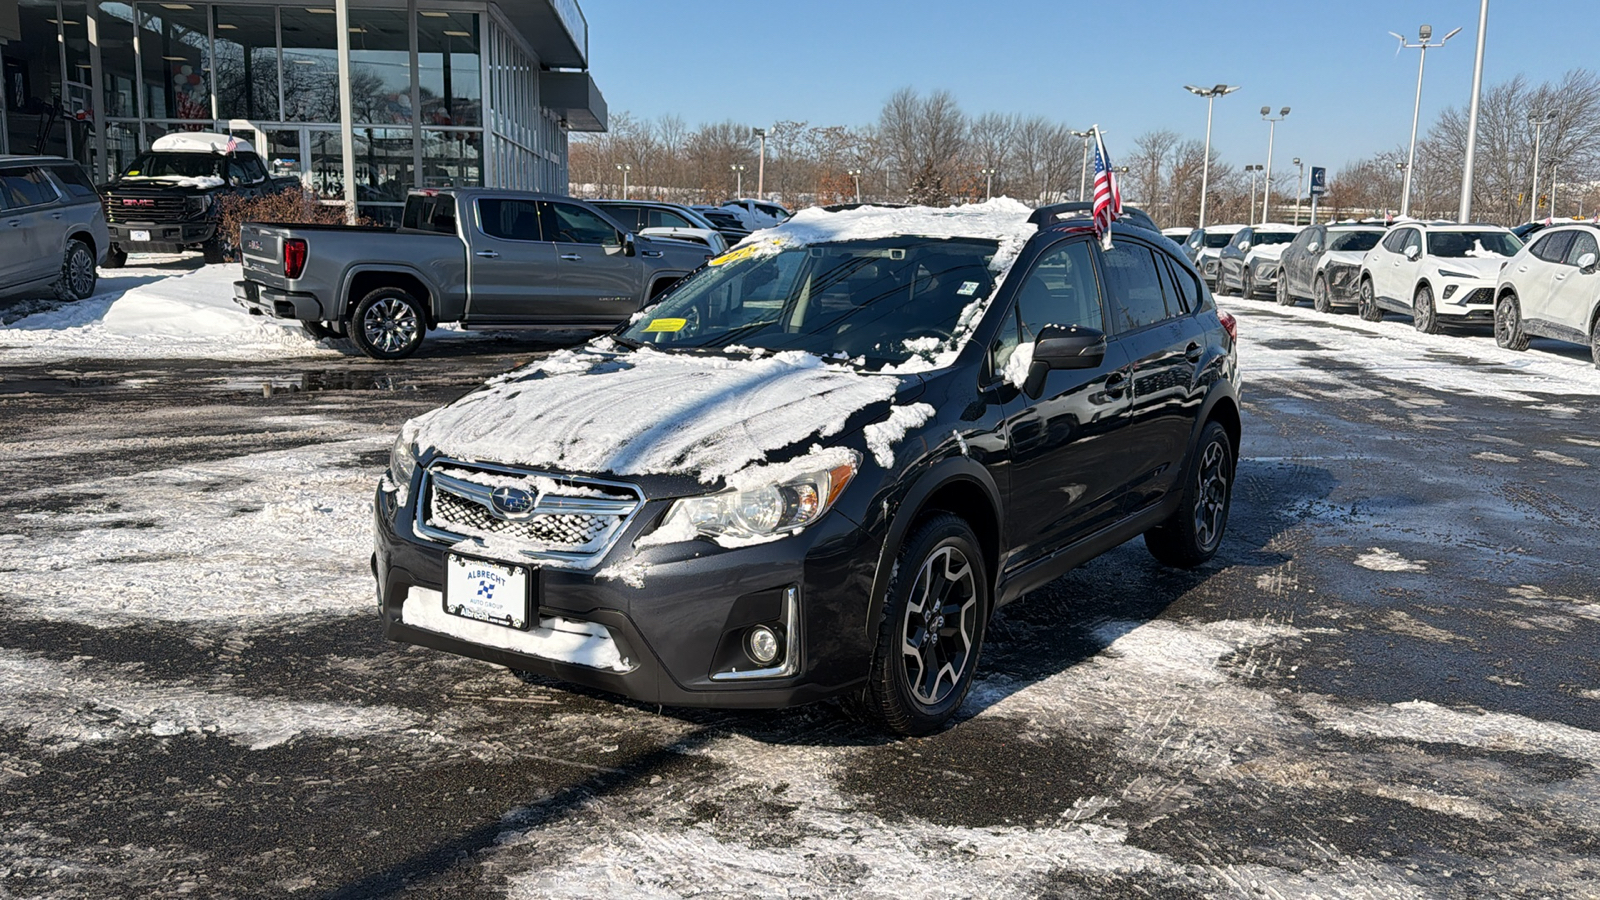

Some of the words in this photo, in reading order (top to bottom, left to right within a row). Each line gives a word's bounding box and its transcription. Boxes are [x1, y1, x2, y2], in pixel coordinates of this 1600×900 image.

[122, 199, 154, 207] GMC
[467, 570, 506, 586] ALBRECHT
[470, 598, 484, 606] AUTO
[485, 601, 504, 610] GROUP
